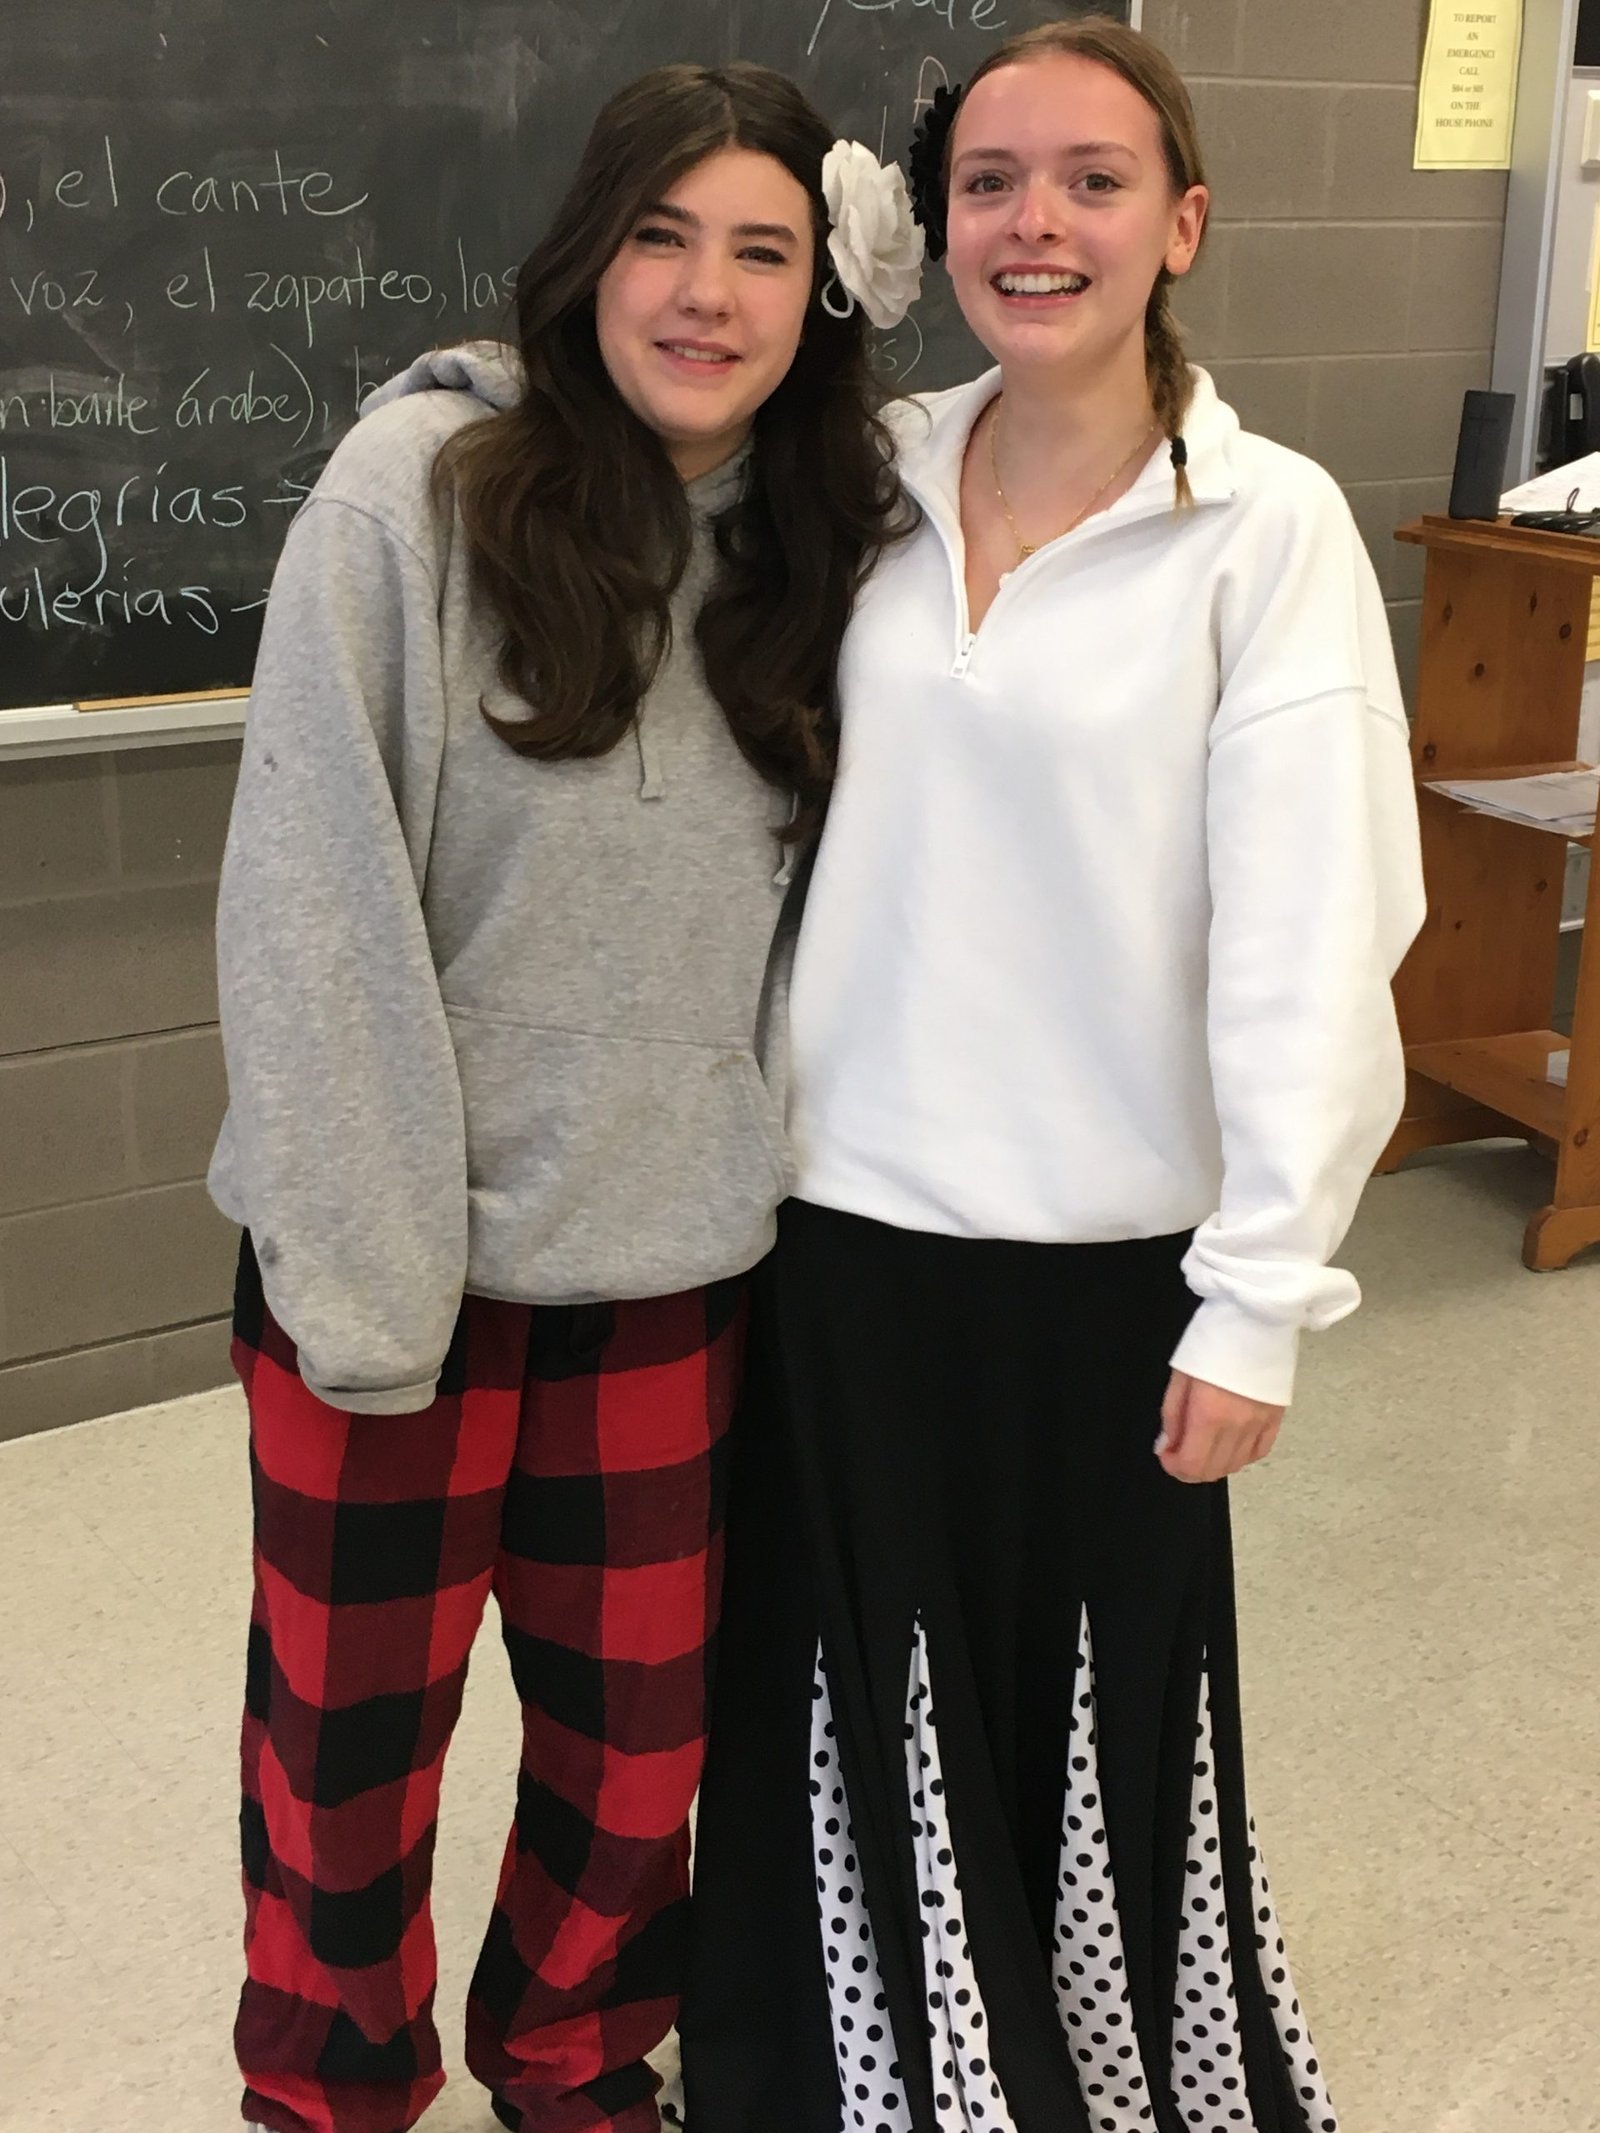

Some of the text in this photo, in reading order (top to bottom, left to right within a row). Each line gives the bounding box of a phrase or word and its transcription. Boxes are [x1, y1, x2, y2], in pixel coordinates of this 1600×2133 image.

[1453, 13, 1497, 24] TO REPORT
[1467, 32, 1479, 40] AN
[1447, 49, 1495, 58] EMERGENCY
[1458, 66, 1480, 76] CALL
[1450, 101, 1481, 110] ON THE
[1435, 118, 1495, 128] HOUSE PHONE
[55, 134, 118, 208] el
[156, 149, 370, 216] cante
[166, 245, 216, 313] el
[243, 245, 447, 349] zapateo,
